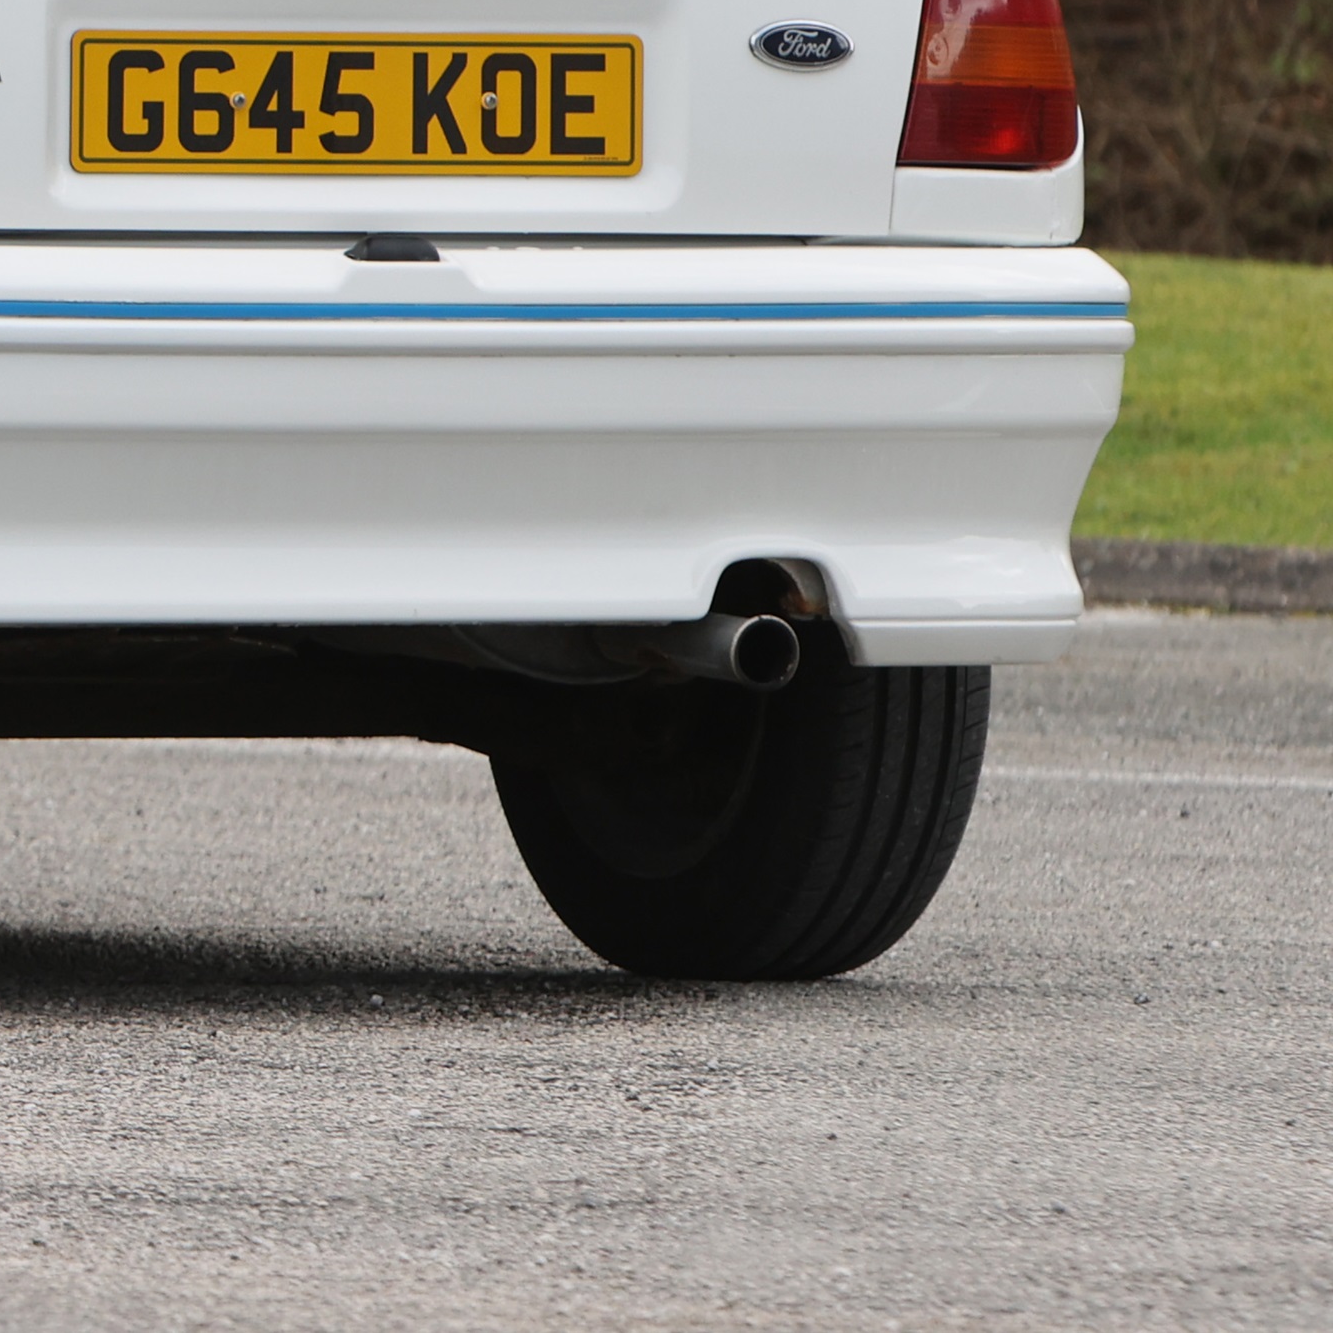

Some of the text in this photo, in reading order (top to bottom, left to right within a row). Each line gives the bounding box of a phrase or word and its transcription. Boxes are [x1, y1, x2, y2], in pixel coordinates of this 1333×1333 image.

[778, 29, 832, 58] Ford
[107, 49, 607, 155] G645 KOE
